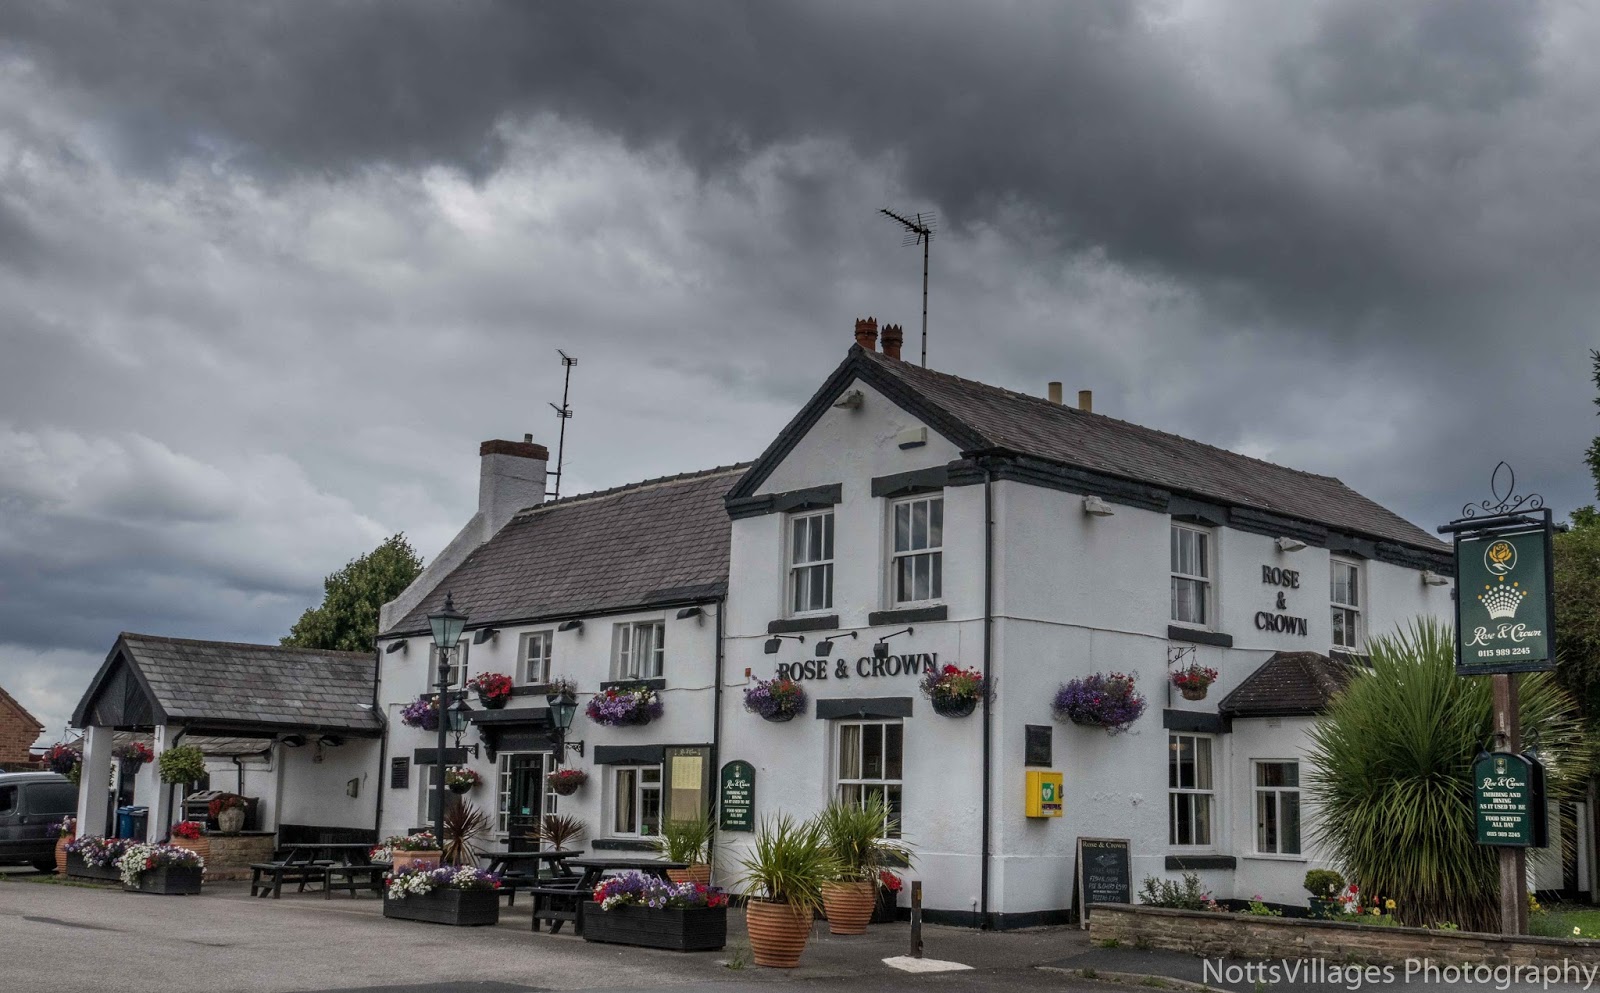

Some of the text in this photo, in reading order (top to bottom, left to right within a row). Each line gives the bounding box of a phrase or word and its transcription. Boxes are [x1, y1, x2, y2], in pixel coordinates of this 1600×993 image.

[1262, 564, 1300, 588] ROSE
[1276, 591, 1286, 610] &
[1254, 611, 1308, 636] CROWN
[1465, 623, 1542, 646] Rose & Crown
[1496, 648, 1510, 656] 989
[1512, 647, 1530, 655] 2245
[778, 653, 938, 682] ROSE & CROWN
[1478, 776, 1525, 790] Rose & Crown
